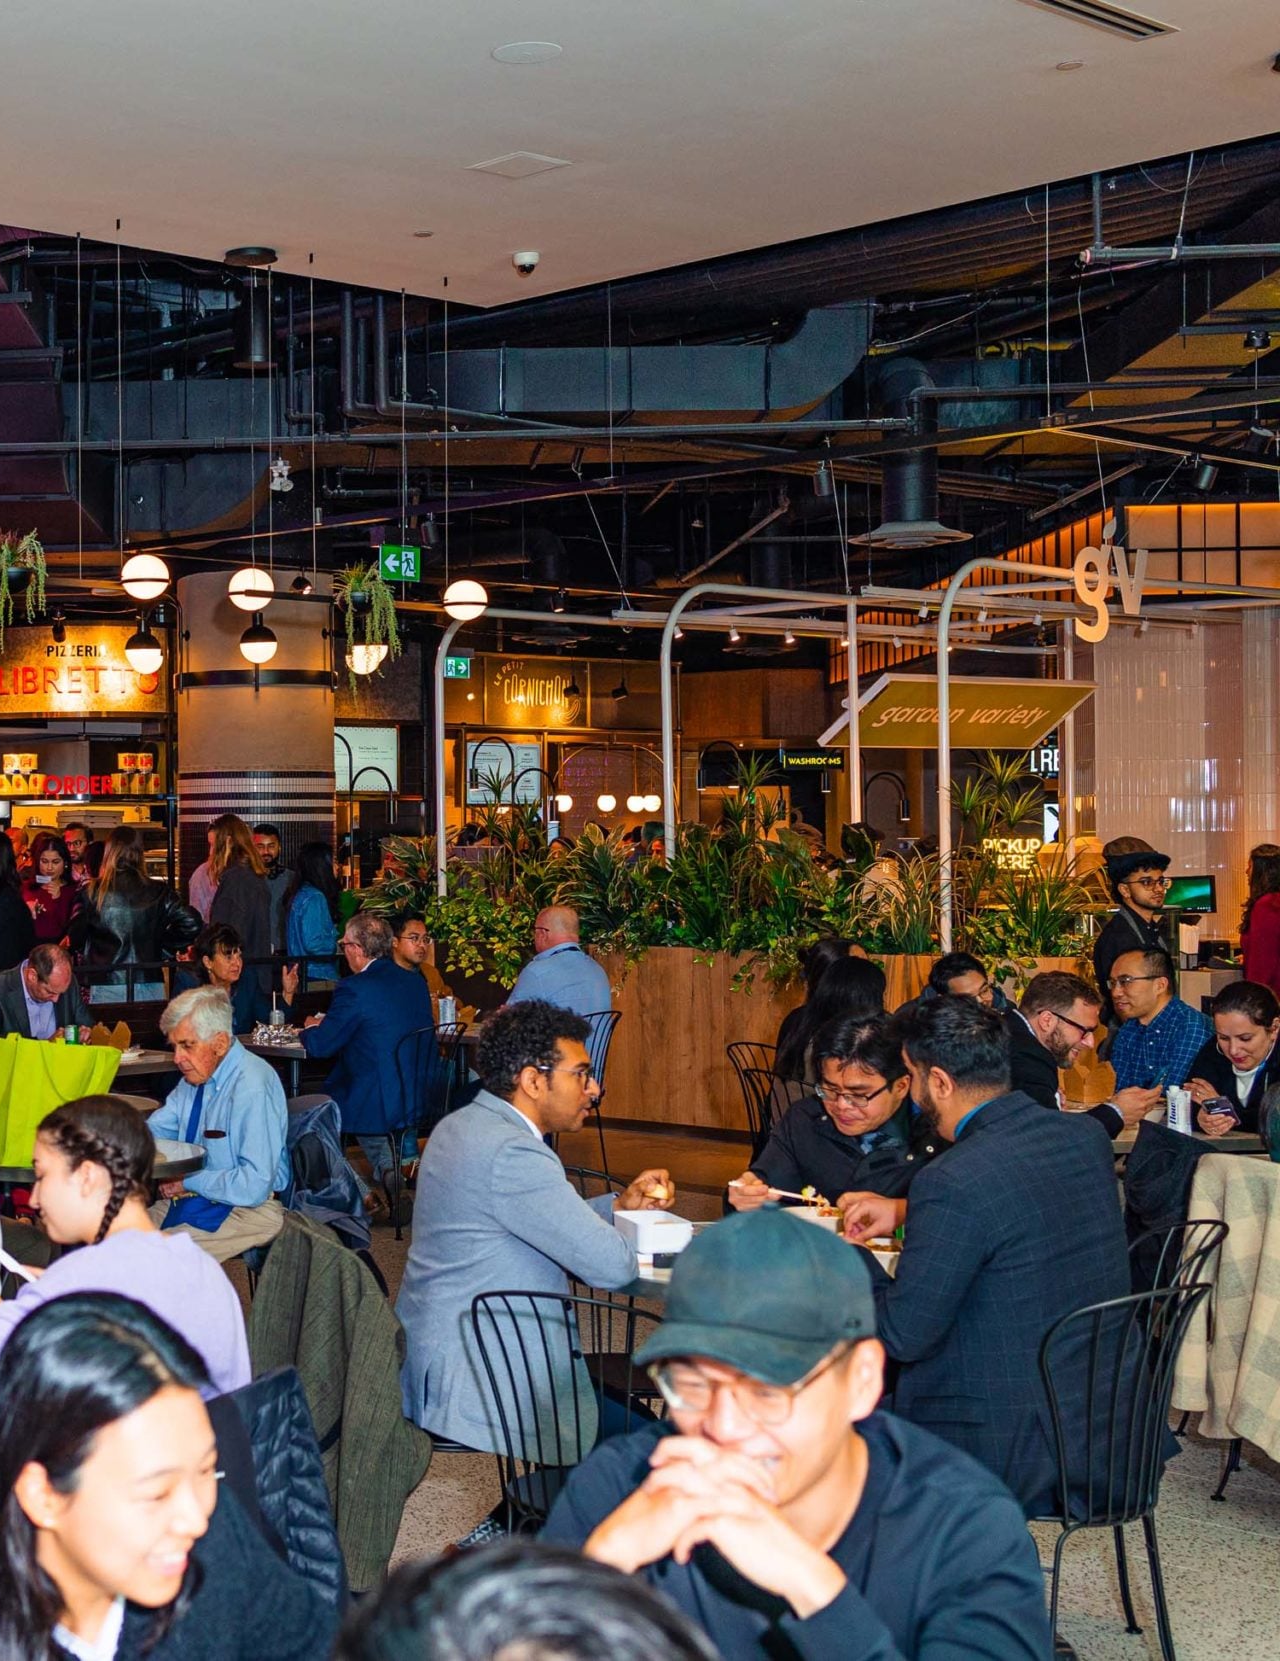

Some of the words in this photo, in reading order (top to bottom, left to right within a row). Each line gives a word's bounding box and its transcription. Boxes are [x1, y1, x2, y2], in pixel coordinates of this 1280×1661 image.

[1074, 544, 1148, 642] gv
[46, 645, 106, 658] PIZZERI
[501, 661, 524, 674] PETIT
[504, 673, 570, 709] CORNICHON
[871, 705, 966, 728] gardn
[967, 704, 1051, 730] variety
[788, 757, 841, 765] WASHROOMS
[42, 774, 113, 795] ORDER
[982, 838, 1041, 854] PICKUP
